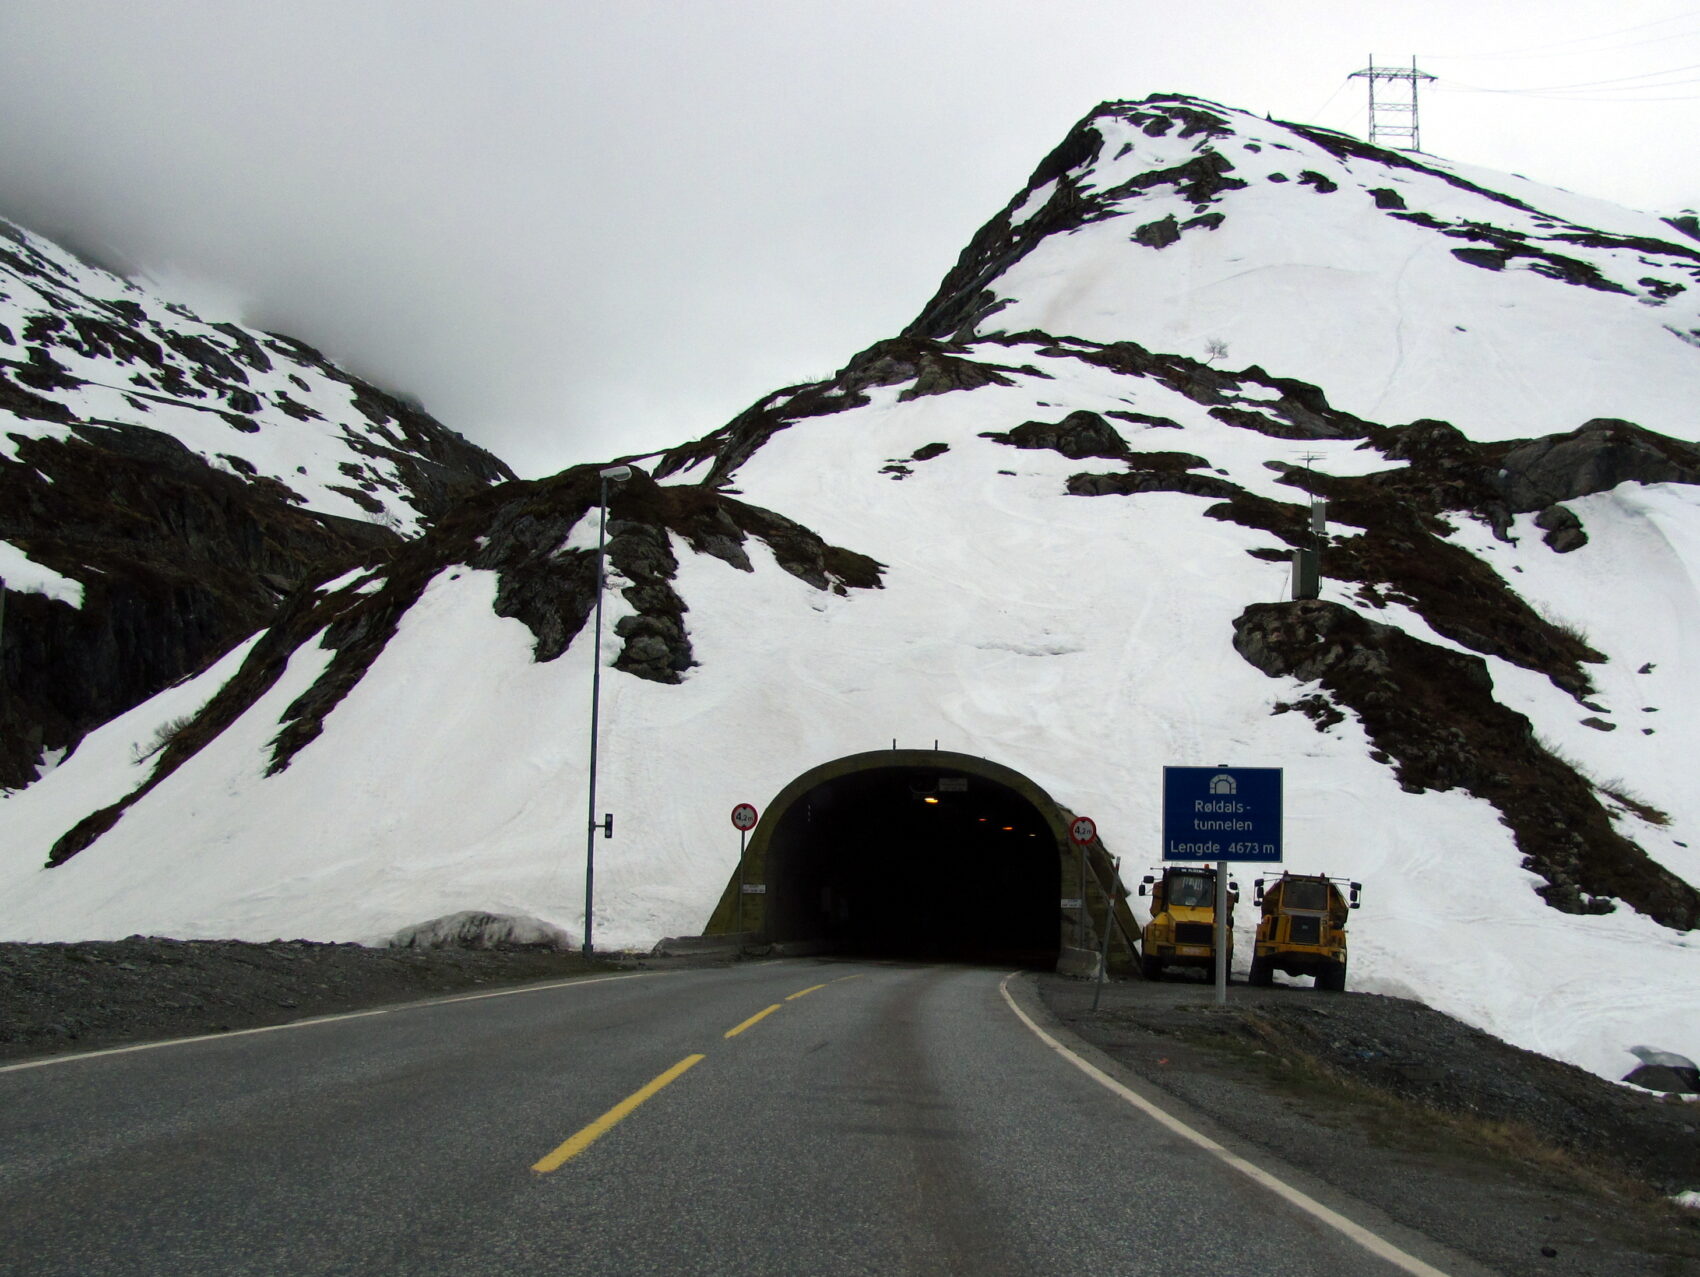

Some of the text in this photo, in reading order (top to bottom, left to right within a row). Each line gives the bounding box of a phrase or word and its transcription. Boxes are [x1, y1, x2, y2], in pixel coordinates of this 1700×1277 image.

[1195, 800, 1251, 813] Røldals-
[1194, 818, 1252, 831] tunnelen
[1170, 840, 1275, 856] Lengde 4673 m
